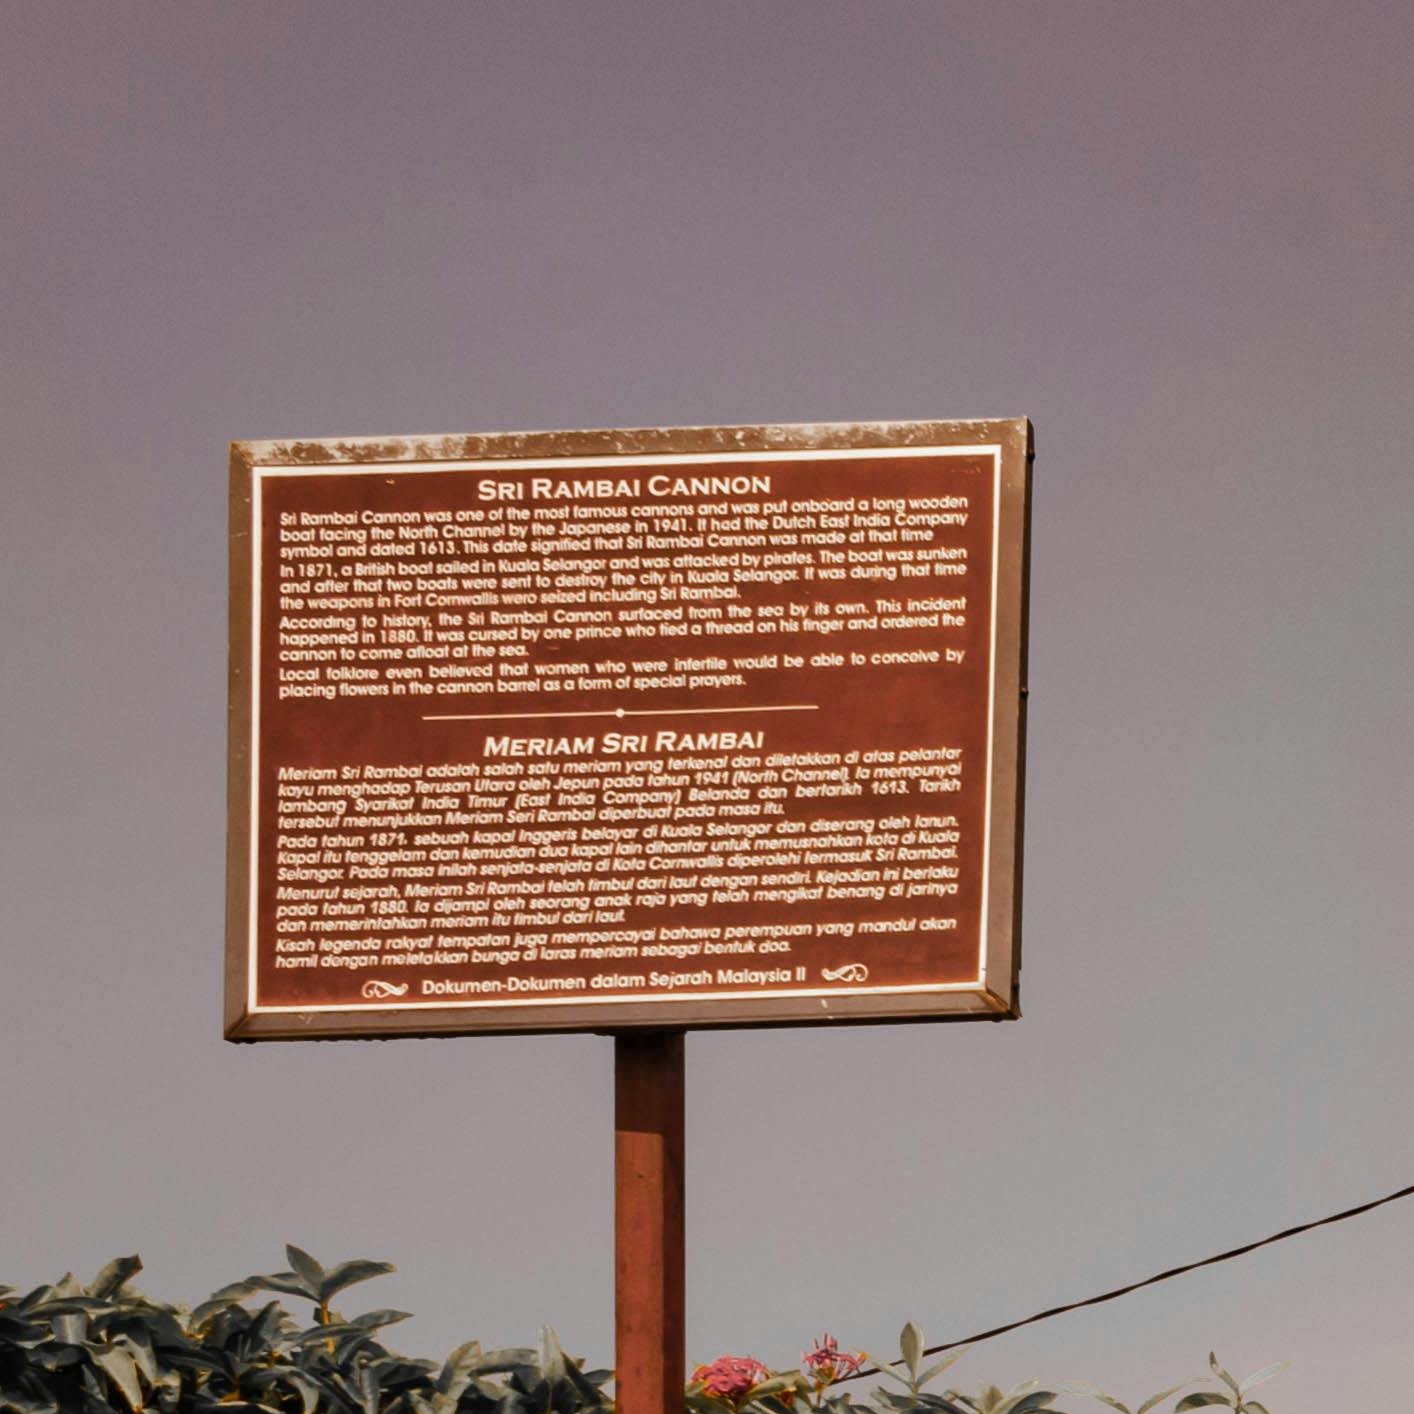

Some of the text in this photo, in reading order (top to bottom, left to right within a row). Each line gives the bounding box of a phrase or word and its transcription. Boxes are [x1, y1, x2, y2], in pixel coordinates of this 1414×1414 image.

[477, 474, 771, 502] SRI RAMBAI CANNON
[299, 510, 359, 526] Rambai
[360, 509, 421, 525] Cannon
[423, 510, 453, 523] was
[455, 509, 486, 523] one
[487, 506, 504, 521] of
[505, 506, 531, 521] the
[533, 505, 571, 520] most
[572, 504, 629, 519] famous
[630, 504, 695, 518] cannons
[696, 501, 729, 516] and
[730, 502, 761, 515] was
[762, 499, 789, 518] put
[790, 496, 855, 513] onboard
[857, 499, 870, 512] a
[872, 497, 907, 515] long
[908, 495, 969, 510] wooden
[279, 511, 969, 546] boat facing the North Channel by the Japanese in 1941. It had the Dutch East India Company
[279, 543, 334, 561] symbol
[335, 541, 368, 557] and
[369, 541, 416, 557] dated
[419, 540, 461, 556] 1613.
[462, 539, 490, 554] This
[491, 537, 528, 554] date
[530, 535, 592, 556] signified
[593, 535, 624, 551] that
[645, 533, 705, 550] Rambai
[706, 532, 767, 548] Cannon
[768, 533, 799, 546] was
[800, 530, 847, 545] made
[848, 529, 866, 544] at
[867, 528, 898, 543] that
[900, 526, 935, 542] time
[279, 564, 295, 578] In
[340, 565, 353, 577] a
[354, 561, 396, 577] British
[397, 561, 434, 576] boat
[435, 559, 480, 575] sailed
[481, 558, 496, 573] in
[497, 558, 541, 573] Kuala
[542, 557, 608, 575] Selangor
[608, 555, 641, 570] and
[640, 556, 671, 569] was
[672, 552, 740, 569] attacked
[741, 552, 762, 570] by
[818, 549, 846, 564] The
[847, 548, 884, 563] boat
[884, 549, 915, 562] was
[915, 546, 968, 561] sunken
[278, 649, 338, 662] cannon
[339, 646, 356, 661] to
[358, 647, 404, 661] come
[405, 644, 450, 660] afloat
[451, 644, 470, 658] at
[471, 643, 497, 658] the
[278, 673, 747, 700] placing flowers in the cannon barrel as a form of special prayers.
[482, 730, 765, 758] MERIAM SRI RAMBAI
[277, 766, 338, 781] Meriam
[363, 764, 424, 779] Rambai
[425, 762, 481, 778] adalah
[482, 761, 525, 777] salah
[526, 760, 561, 776] satu
[562, 759, 623, 774] meriam
[624, 759, 665, 776] yang
[730, 754, 762, 769] dan
[764, 751, 842, 768] diletakkan
[843, 750, 860, 765] di
[862, 749, 896, 764] atas
[897, 746, 963, 765] pelantar
[277, 813, 343, 830] tersebut
[342, 812, 443, 830] menunjukkan
[444, 810, 505, 826] Meriam
[505, 808, 536, 824] Seri
[536, 807, 597, 823] Rambai
[597, 803, 673, 823] diperbuat
[673, 803, 717, 821] pada
[717, 803, 762, 817] masa
[274, 938, 316, 953] Kisah
[384, 934, 435, 953] rakyat
[435, 933, 512, 952] tempatan
[512, 931, 549, 949] juga
[550, 927, 657, 947] mempercayai
[658, 926, 722, 941] bahawa
[723, 923, 813, 942] perempuan
[815, 922, 856, 938] yang
[857, 917, 917, 933] mandul
[919, 916, 958, 931] akan
[275, 918, 308, 933] dan
[309, 915, 428, 932] memerintahkan
[429, 912, 490, 929] meriam
[491, 911, 512, 927] itu
[513, 911, 562, 926] timbul
[561, 909, 595, 925] dari
[274, 953, 319, 969] hamil
[319, 952, 379, 970] dengan
[380, 948, 469, 966] meletakkan
[470, 946, 522, 966] bunga
[522, 946, 539, 962] di
[539, 946, 577, 961] laras
[579, 942, 639, 960] meriam
[640, 941, 703, 960] sebagai
[703, 939, 757, 955] bentuk
[421, 965, 807, 995] Dokumen-Dokumen dalam Sejarah Malaysia II
